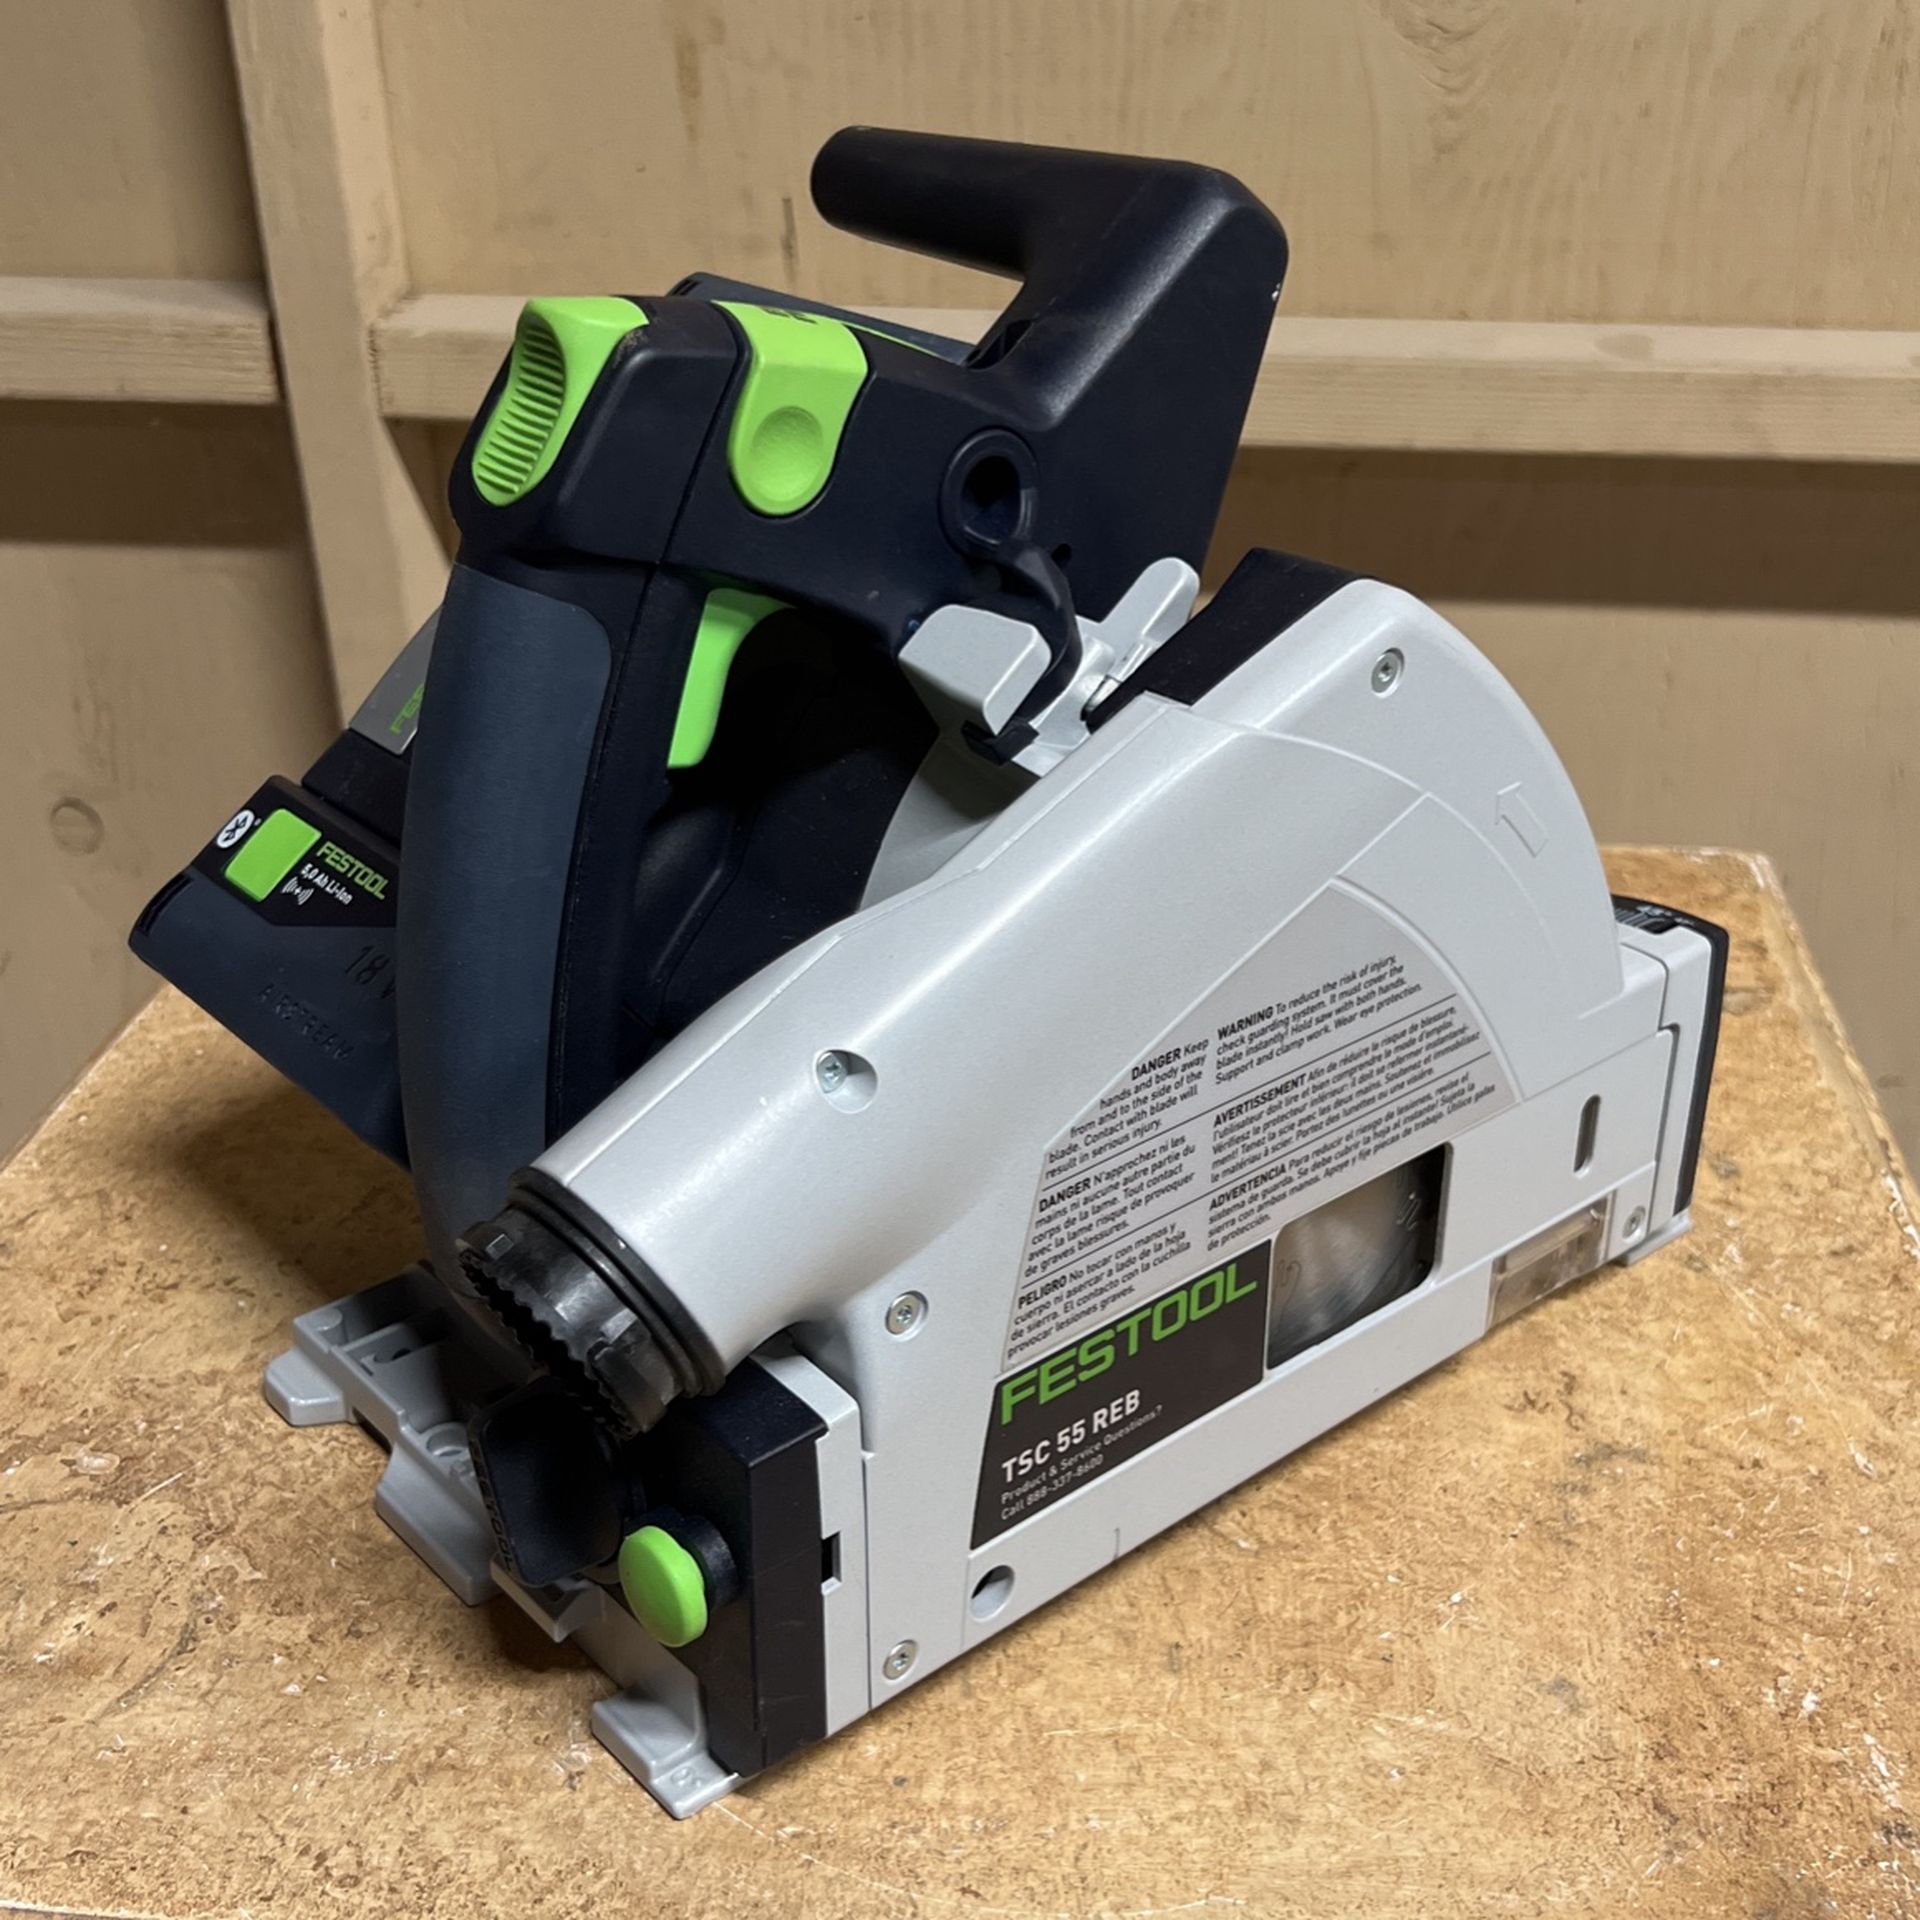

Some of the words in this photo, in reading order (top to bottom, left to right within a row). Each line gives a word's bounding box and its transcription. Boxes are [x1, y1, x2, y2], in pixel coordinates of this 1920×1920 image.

[314, 873, 328, 888] Ah
[316, 840, 390, 900] FESTOOL
[345, 945, 392, 984] 18
[1218, 1005, 1274, 1040] WARNING
[1277, 1002, 1287, 1014] To
[1289, 988, 1321, 1008] reduce
[1323, 981, 1338, 993] the
[1339, 970, 1357, 986] risk
[1359, 963, 1369, 978] of
[1216, 1051, 1244, 1070] blade
[1291, 1016, 1314, 1035] Hold
[1315, 1010, 1334, 1025] saw
[1335, 999, 1355, 1015] with
[1356, 989, 1377, 1006] both
[1378, 977, 1407, 995] hands.
[1216, 1058, 1254, 1084] Support
[1256, 1048, 1275, 1066] and
[1276, 1037, 1305, 1056] clamp
[1307, 1024, 1331, 1042] work.
[1334, 1011, 1358, 1029] Wear
[1360, 1004, 1376, 1018] eye
[1217, 1034, 1246, 1055] check
[1248, 1015, 1291, 1044] guarding
[1292, 1000, 1327, 1022] system.
[1330, 993, 1337, 1004] It
[1338, 981, 1362, 1000] must
[1364, 971, 1388, 989] cover
[1390, 964, 1404, 977] the
[1100, 1088, 1132, 1109] hands
[1134, 1075, 1153, 1094] and
[1155, 1066, 1179, 1084] body
[1181, 1054, 1207, 1072] away
[1132, 1047, 1182, 1080] DANGER
[1184, 1038, 1210, 1056] Keep
[1049, 1143, 1080, 1163] blade.
[1084, 1119, 1125, 1146] Contact
[1126, 1109, 1148, 1126] with
[1150, 1095, 1178, 1116] blade
[1180, 1083, 1198, 1101] will
[1070, 1120, 1096, 1138] from
[1098, 1107, 1118, 1125] and
[1120, 1103, 1131, 1115] to
[1132, 1095, 1149, 1109] the
[1151, 1084, 1172, 1100] side
[1174, 1075, 1185, 1090] of
[1186, 1070, 1203, 1084] the
[1214, 1072, 1306, 1127] AVERTISSEMENT
[1035, 1206, 1069, 1229] mains
[1070, 1197, 1081, 1211] ni
[1083, 1181, 1121, 1205] aucune
[1123, 1166, 1150, 1186] autre
[1151, 1151, 1181, 1175] partie
[1183, 1144, 1196, 1157] du
[1039, 1177, 1091, 1212] DANGER
[1159, 1140, 1169, 1154] ni
[1171, 1135, 1186, 1148] les
[1045, 1156, 1078, 1179] result
[1079, 1152, 1090, 1163] in
[1092, 1132, 1131, 1158] serious
[1133, 1118, 1162, 1138] injury.
[1210, 1163, 1287, 1211] ADVERTENCIA
[1028, 1243, 1053, 1261] avec
[1055, 1236, 1065, 1248] la
[1067, 1222, 1094, 1241] lame
[1096, 1205, 1129, 1227] risque
[1131, 1198, 1143, 1210] de
[1145, 1172, 1195, 1206] provoquer
[1032, 1224, 1062, 1245] corps
[1064, 1216, 1077, 1229] de
[1079, 1210, 1090, 1221] la
[1092, 1196, 1119, 1215] lame.
[1124, 1181, 1145, 1199] Tout
[1147, 1162, 1183, 1188] contact
[1014, 1300, 1052, 1325] cuerpo
[1054, 1292, 1064, 1305] ni
[1107, 1268, 1114, 1277] a
[1116, 1256, 1138, 1272] lado
[1139, 1248, 1152, 1260] de
[1154, 1242, 1164, 1253] la
[1165, 1230, 1186, 1247] hoja
[1018, 1274, 1067, 1309] PELIGRO
[1069, 1269, 1085, 1282] No
[1086, 1254, 1113, 1274] tocar
[1115, 1244, 1134, 1259] con
[1135, 1226, 1169, 1249] manos
[1170, 1222, 1176, 1234] y
[1025, 1264, 1039, 1277] de
[1041, 1245, 1076, 1272] graves
[1078, 1219, 1129, 1251] blessures.
[1008, 1326, 1054, 1359] provocar
[1056, 1303, 1099, 1331] lesiones
[1100, 1284, 1135, 1311] graves.
[1011, 1328, 1025, 1341] de
[1027, 1311, 1059, 1333] sierra.
[1064, 1299, 1075, 1314] El
[1076, 1278, 1120, 1306] contacto
[1122, 1268, 1140, 1283] con
[1141, 1262, 1151, 1272] la
[1153, 1241, 1191, 1266] cuchilla
[1001, 1262, 1258, 1426] FESTOOL
[1000, 1468, 1047, 1505] Product
[1048, 1462, 1058, 1478] &
[1060, 1443, 1102, 1473] Service
[1103, 1404, 1163, 1445] Questions?
[1002, 1439, 1051, 1483] TSC
[1056, 1419, 1087, 1454] 55
[1092, 1389, 1142, 1435] REB
[1001, 1495, 1025, 1520] Call
[1026, 1453, 1105, 1504] 888-337-8600
